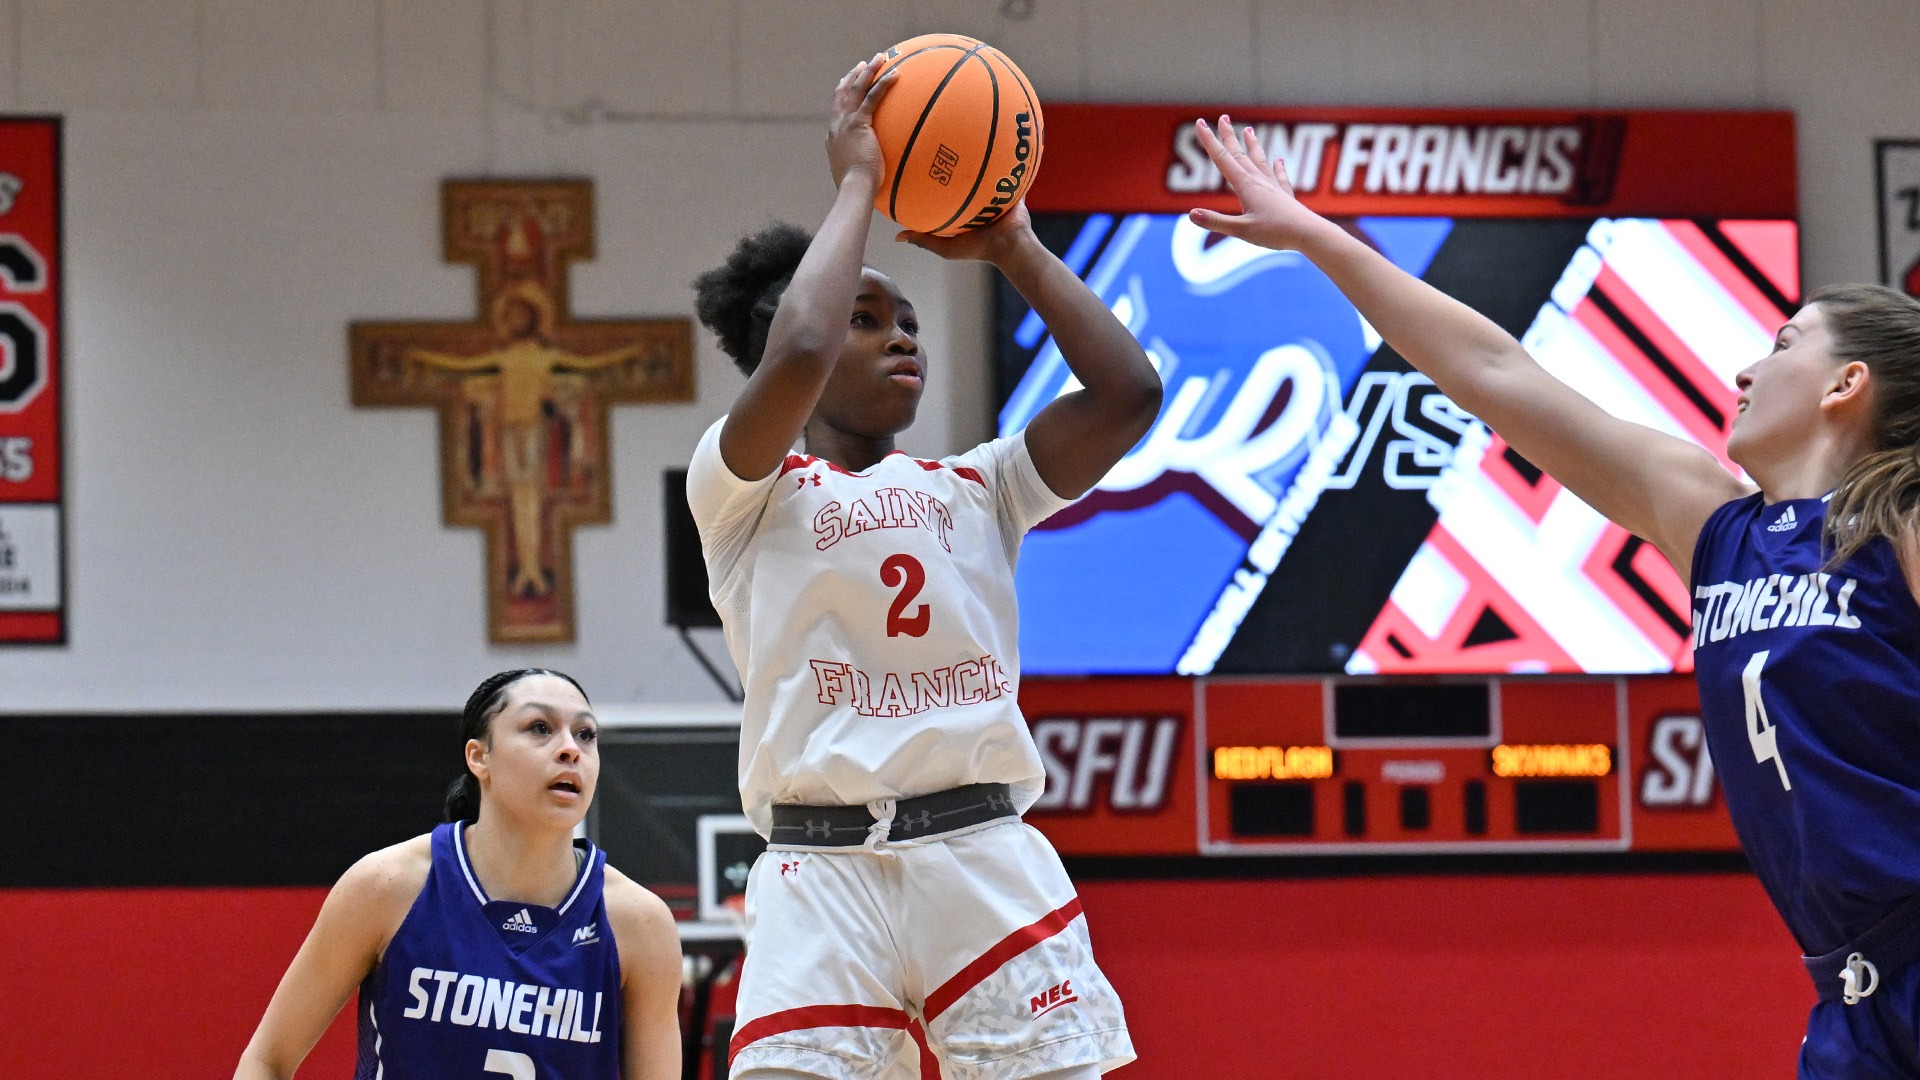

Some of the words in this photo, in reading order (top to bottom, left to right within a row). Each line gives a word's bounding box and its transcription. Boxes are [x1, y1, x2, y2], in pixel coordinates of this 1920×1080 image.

[929, 143, 960, 187] SFU
[1333, 124, 1581, 194] FRANCIS
[813, 487, 954, 554] SAINT
[879, 553, 931, 637] 2
[1742, 649, 1792, 791] 4
[1032, 718, 1178, 810] SFU
[502, 921, 538, 934] adidas
[403, 966, 603, 1043] STONEHILL
[1030, 979, 1074, 1015] NEC
